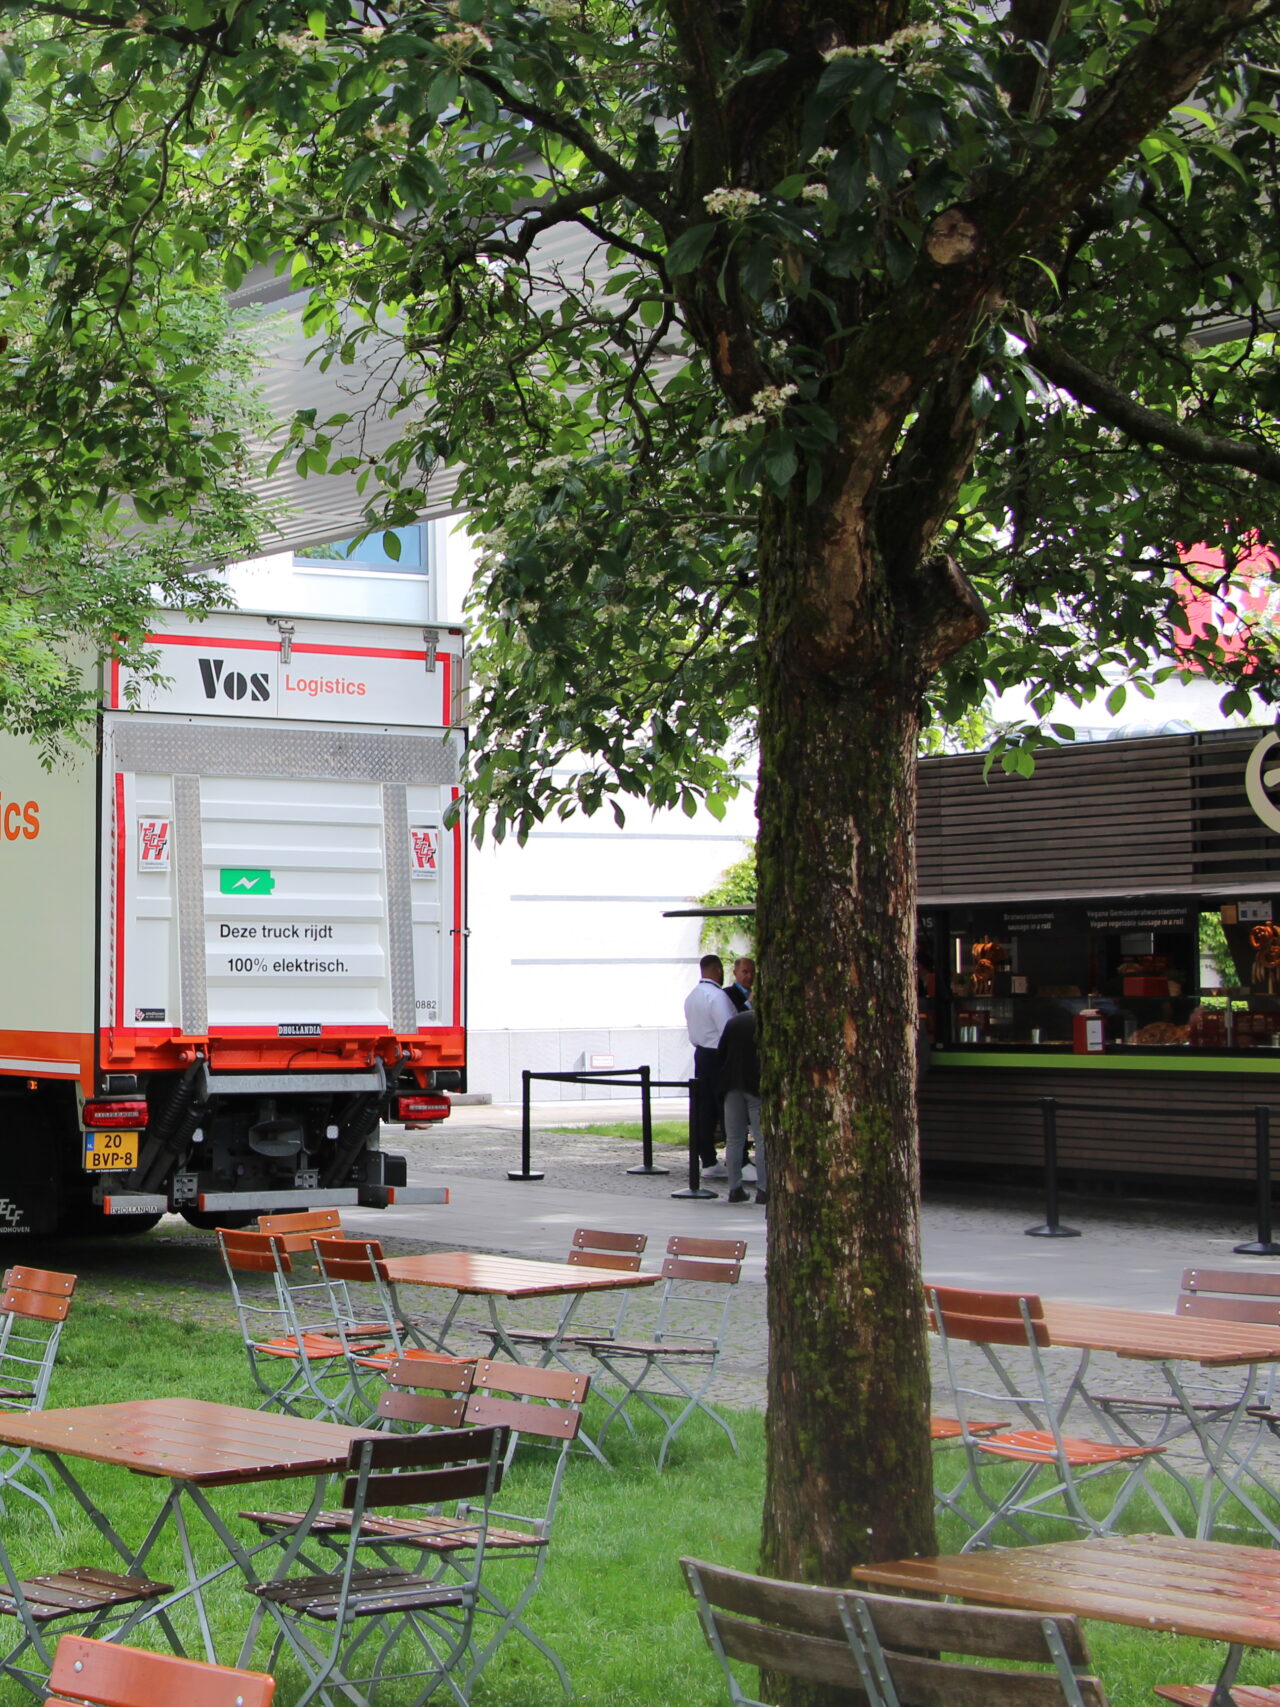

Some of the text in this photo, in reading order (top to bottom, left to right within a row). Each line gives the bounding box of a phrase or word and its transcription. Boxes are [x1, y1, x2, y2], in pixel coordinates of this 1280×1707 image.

[198, 658, 367, 702] Vos Logistics
[220, 924, 333, 940] Deze truck rijdt
[227, 958, 349, 973] 100% elektrisch.
[278, 1025, 321, 1035] DHOLLANDIA
[104, 1134, 122, 1148] 20
[92, 1152, 133, 1166] BVP-8
